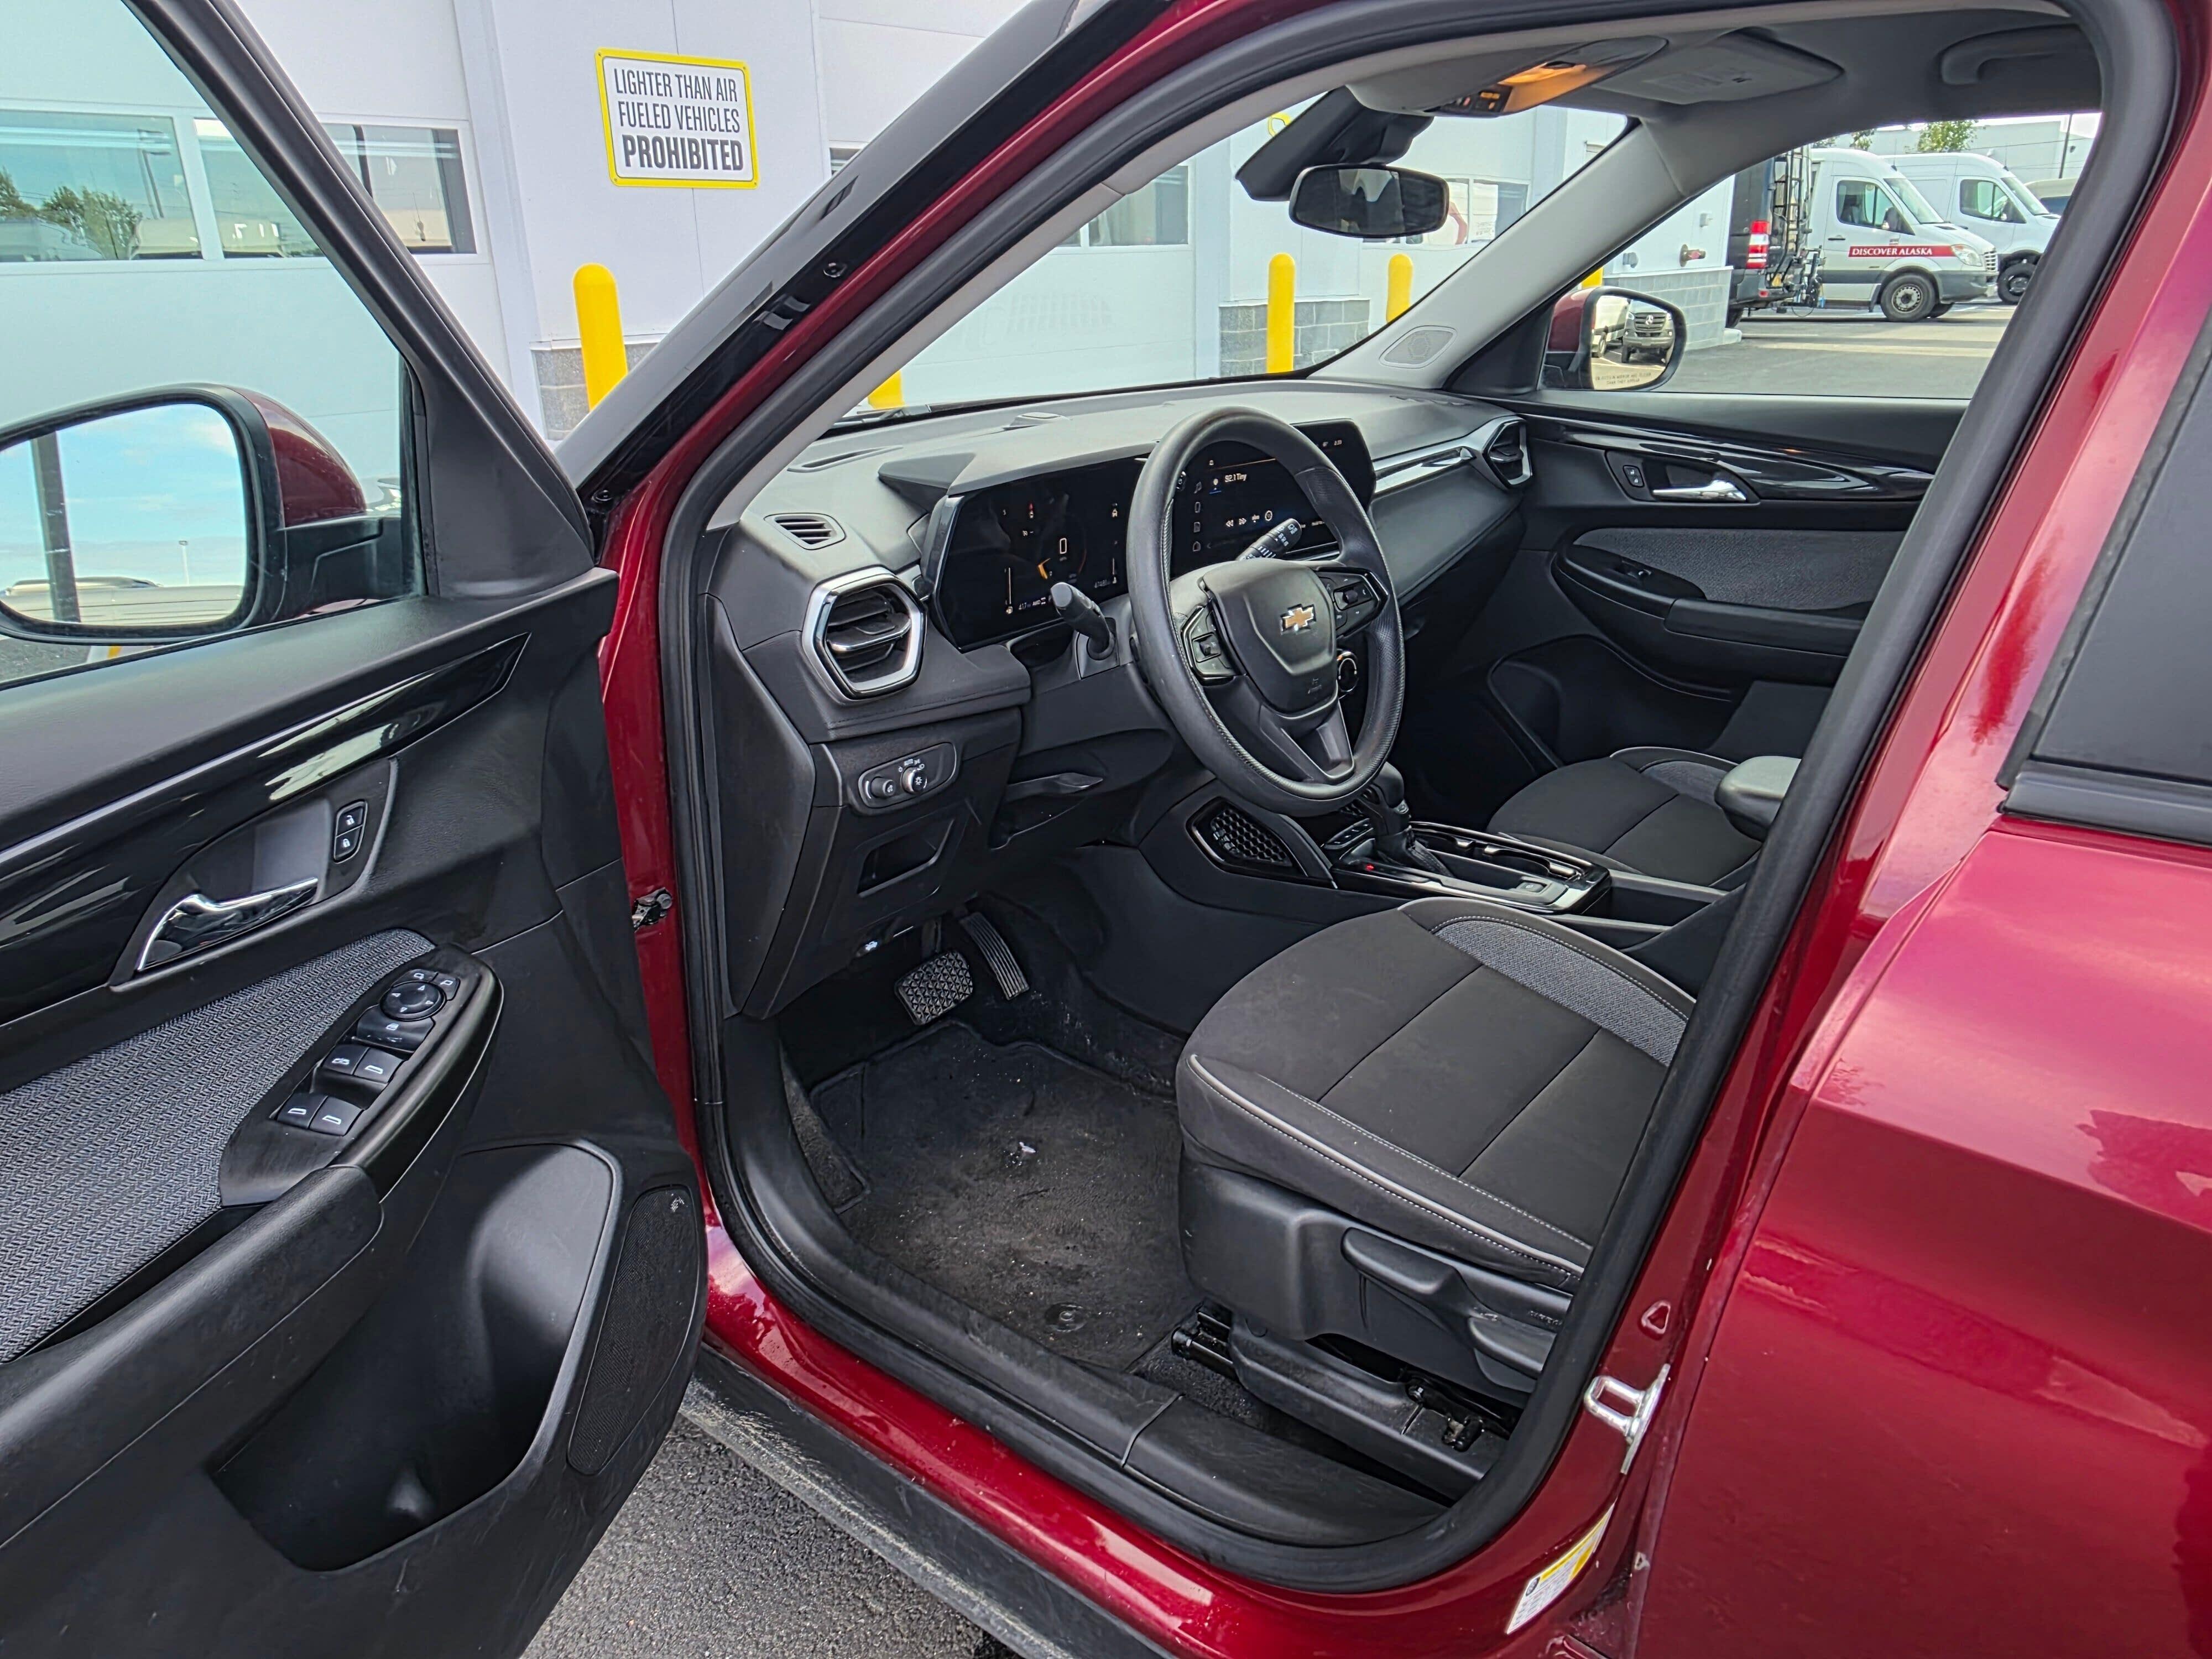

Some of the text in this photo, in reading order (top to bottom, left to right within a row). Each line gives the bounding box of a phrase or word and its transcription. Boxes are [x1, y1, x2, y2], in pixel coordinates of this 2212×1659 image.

[614, 68, 738, 102] LIGHTER THAN AIR
[618, 101, 740, 133] FUELED VEHICLES
[622, 134, 744, 171] PROHIBITED
